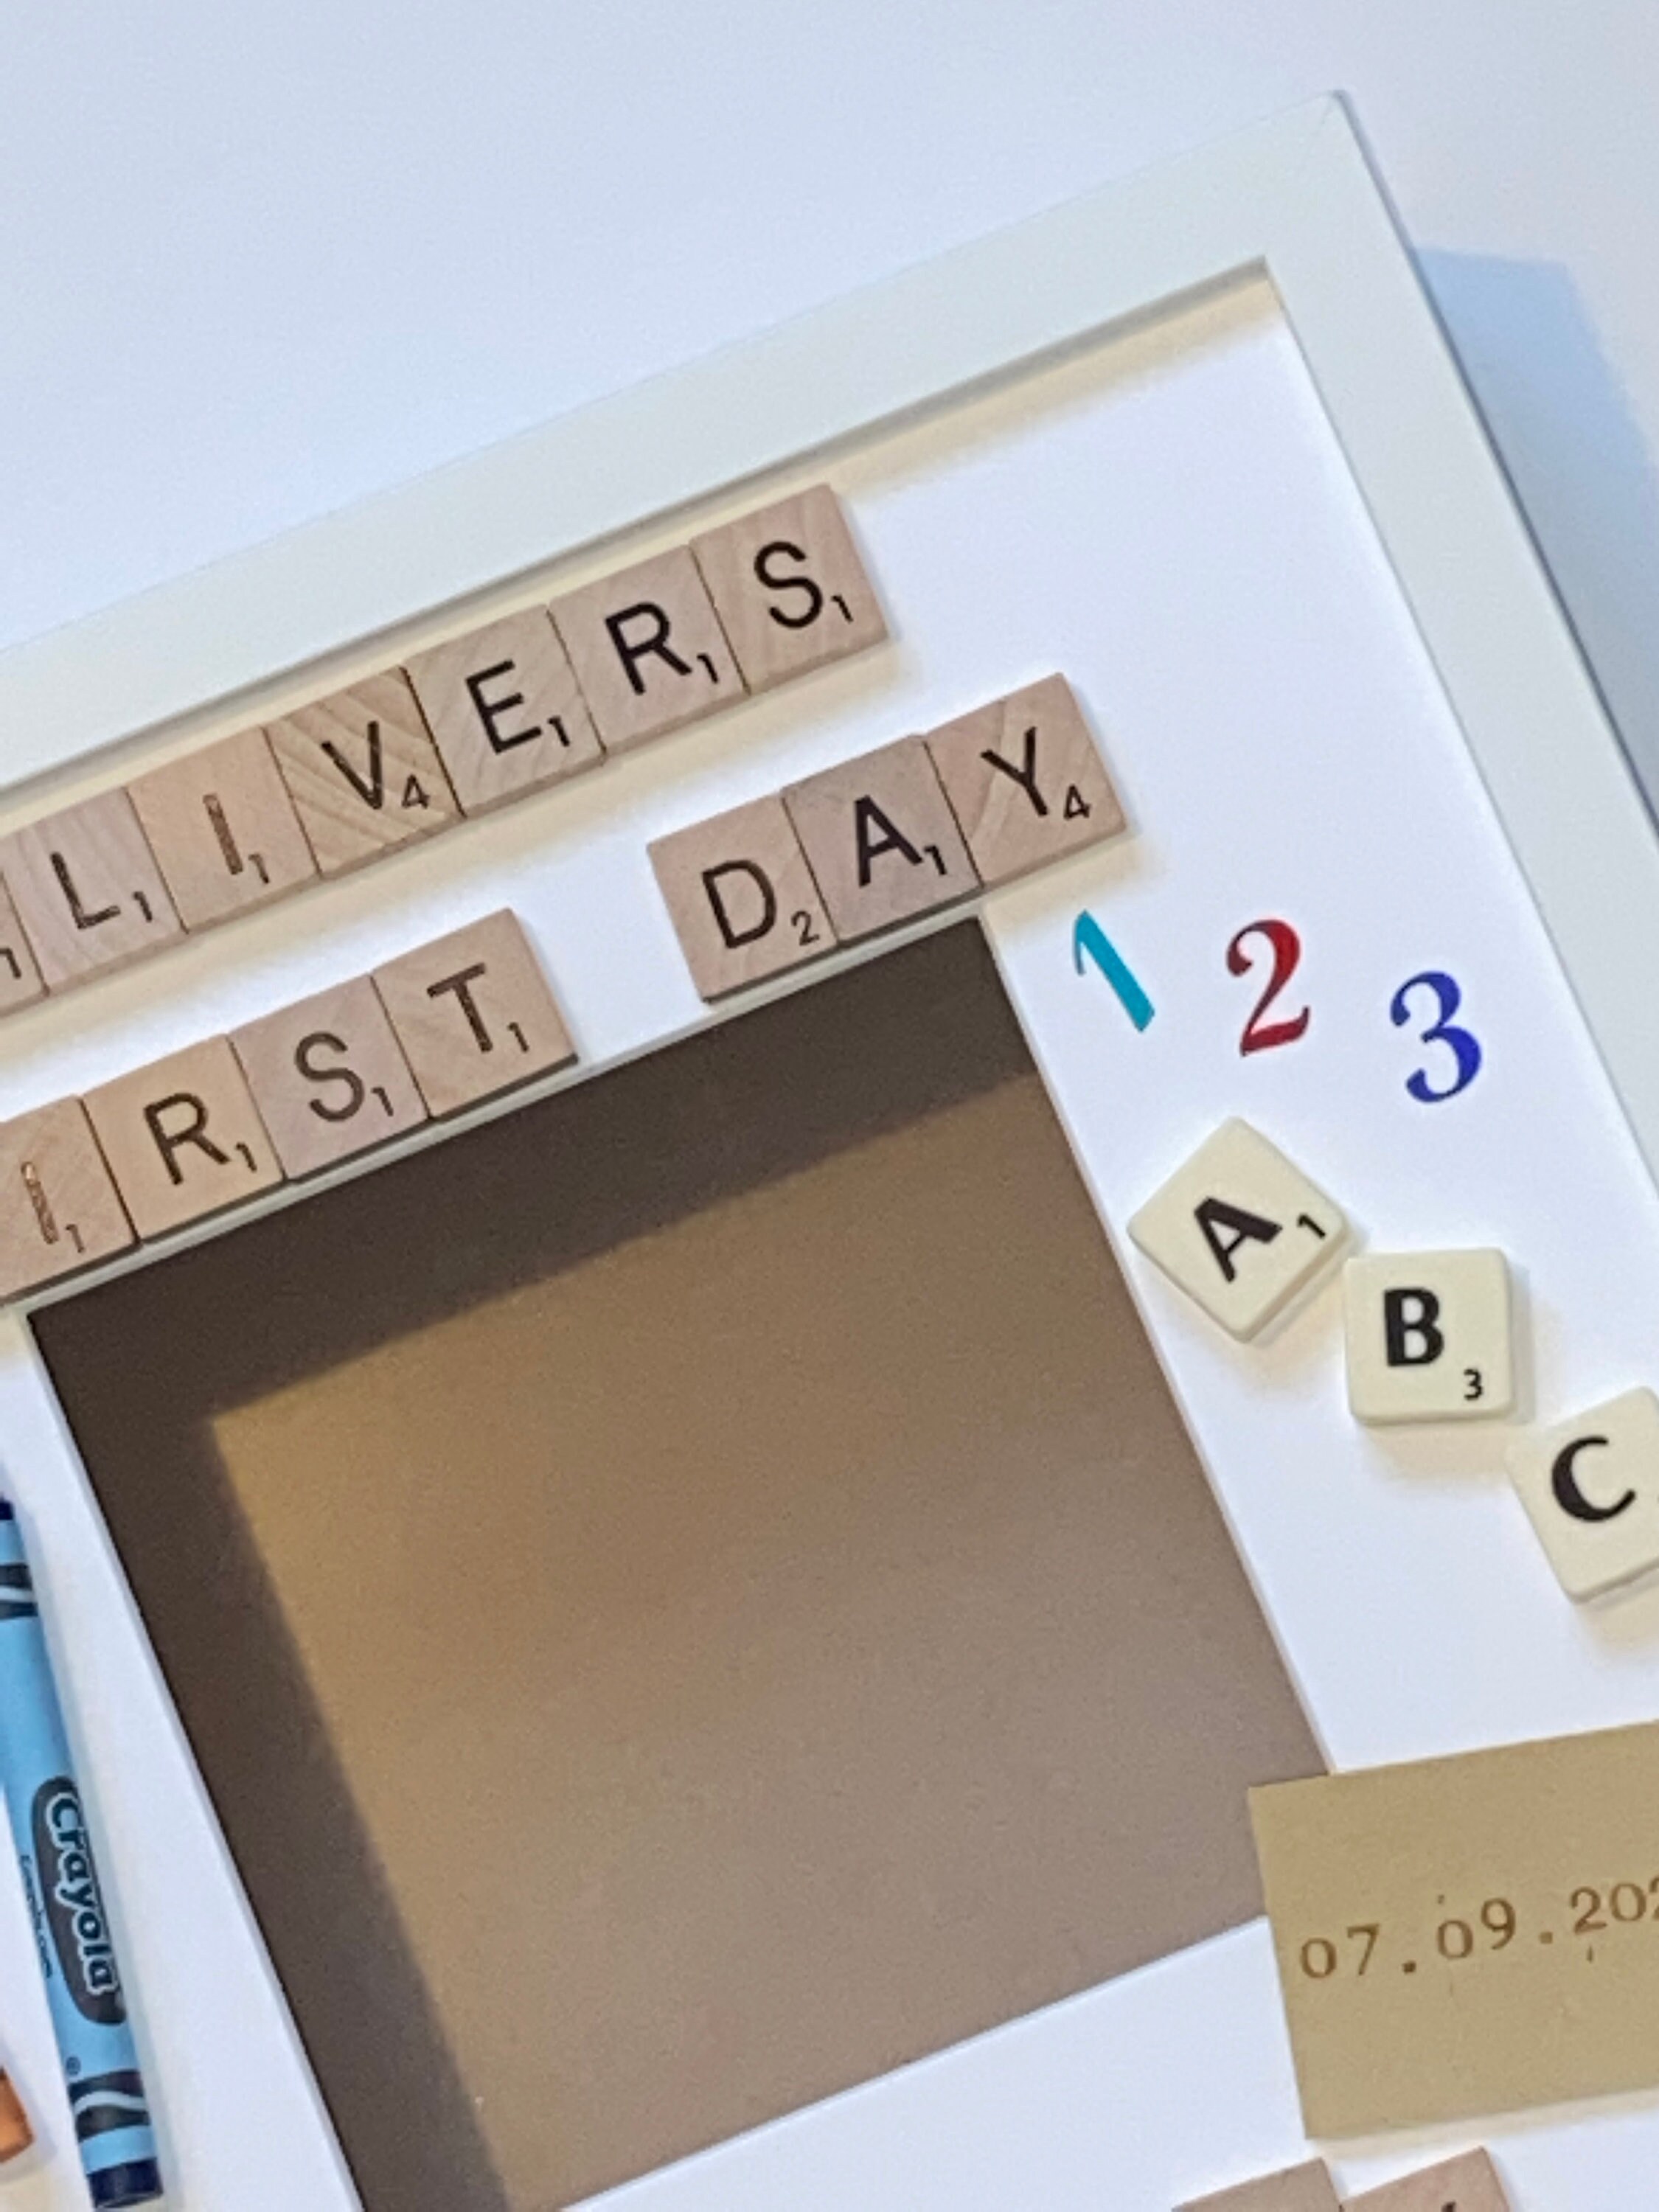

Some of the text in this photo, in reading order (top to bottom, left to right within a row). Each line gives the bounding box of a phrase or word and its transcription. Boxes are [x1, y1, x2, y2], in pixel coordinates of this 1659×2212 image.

[1073, 909, 1482, 1103] 1 2 3
[1193, 1196, 1283, 1284] A
[1296, 1213, 1326, 1240] 1
[1383, 1287, 1445, 1367] B
[1464, 1368, 1484, 1400] 3
[1551, 1435, 1636, 1523] C
[47, 1793, 119, 1994] Crayola
